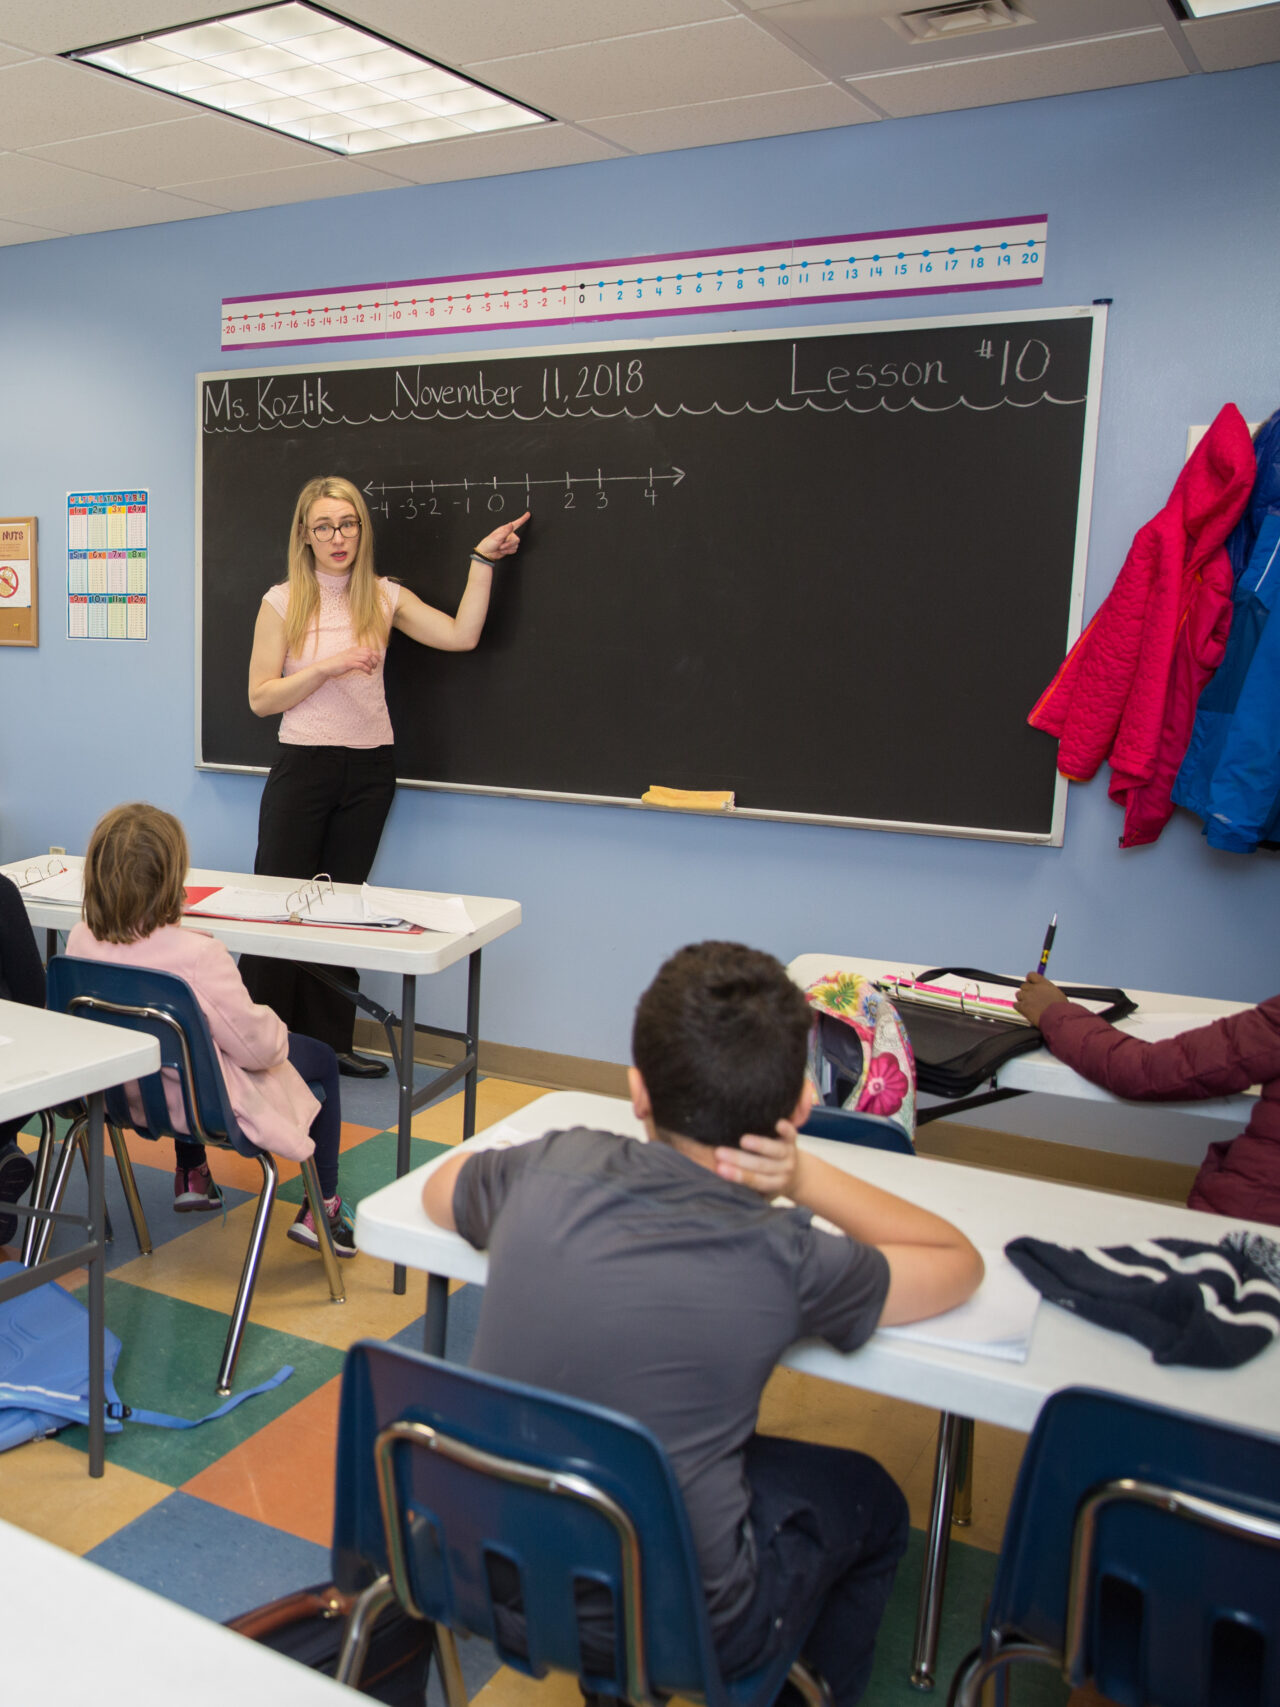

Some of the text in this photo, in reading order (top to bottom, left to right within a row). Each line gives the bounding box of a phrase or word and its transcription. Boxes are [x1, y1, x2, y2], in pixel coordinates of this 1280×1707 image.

[223, 324, 236, 335] -20
[238, 323, 251, 333] -19
[253, 322, 266, 332] -18
[270, 320, 283, 330] -17
[285, 319, 299, 329] -16
[303, 317, 316, 328] -15
[319, 316, 332, 326] -14
[335, 315, 349, 325] -13
[352, 313, 365, 324] -12
[369, 312, 382, 322] -11
[388, 310, 402, 320] -10
[407, 308, 418, 318] -9
[425, 307, 436, 317] -8
[444, 305, 454, 315] -7
[461, 303, 472, 314] -6
[481, 302, 491, 312] -5
[499, 300, 510, 310] -4
[518, 298, 529, 309] -3
[537, 297, 548, 308] -2
[558, 295, 567, 305] -1
[578, 293, 586, 304] 0
[616, 290, 625, 301] 2
[635, 288, 644, 299] 3
[655, 286, 663, 297] 4
[675, 284, 683, 296] 5
[695, 282, 703, 294] 6
[715, 280, 724, 292] 7
[736, 279, 744, 290] 8
[757, 276, 766, 288] 9
[777, 274, 790, 286] 10
[798, 272, 809, 284] 11
[821, 270, 835, 282] 12
[845, 268, 859, 280] 13
[869, 265, 883, 278] 14
[894, 263, 908, 276] 15
[919, 261, 934, 274] 16
[944, 258, 959, 272] 17
[970, 256, 985, 269] 18
[996, 254, 1011, 267] 19
[1021, 251, 1040, 265] 20
[205, 380, 249, 425] Ms.
[257, 377, 334, 420] Kozlik
[395, 365, 523, 408] November
[791, 343, 948, 395] Lesson
[973, 338, 1051, 386] #10
[70, 493, 146, 503] MULTIPLICATION TABLE
[92, 505, 102, 514] 2x
[111, 505, 122, 513] 3x
[131, 504, 141, 512] 4x
[372, 501, 389, 519] -4
[399, 498, 418, 519] -3
[419, 497, 442, 515] -2
[453, 497, 469, 514] -1
[487, 493, 504, 511] 0
[563, 492, 577, 509] 2
[596, 492, 609, 509] 3
[644, 489, 658, 506] 4
[2, 530, 24, 541] NUTS
[73, 551, 83, 559] 5x
[111, 550, 122, 558] 7x
[131, 550, 142, 558] 8x
[91, 595, 105, 603] 10x
[112, 595, 123, 603] 11x
[130, 595, 143, 604] 12x
